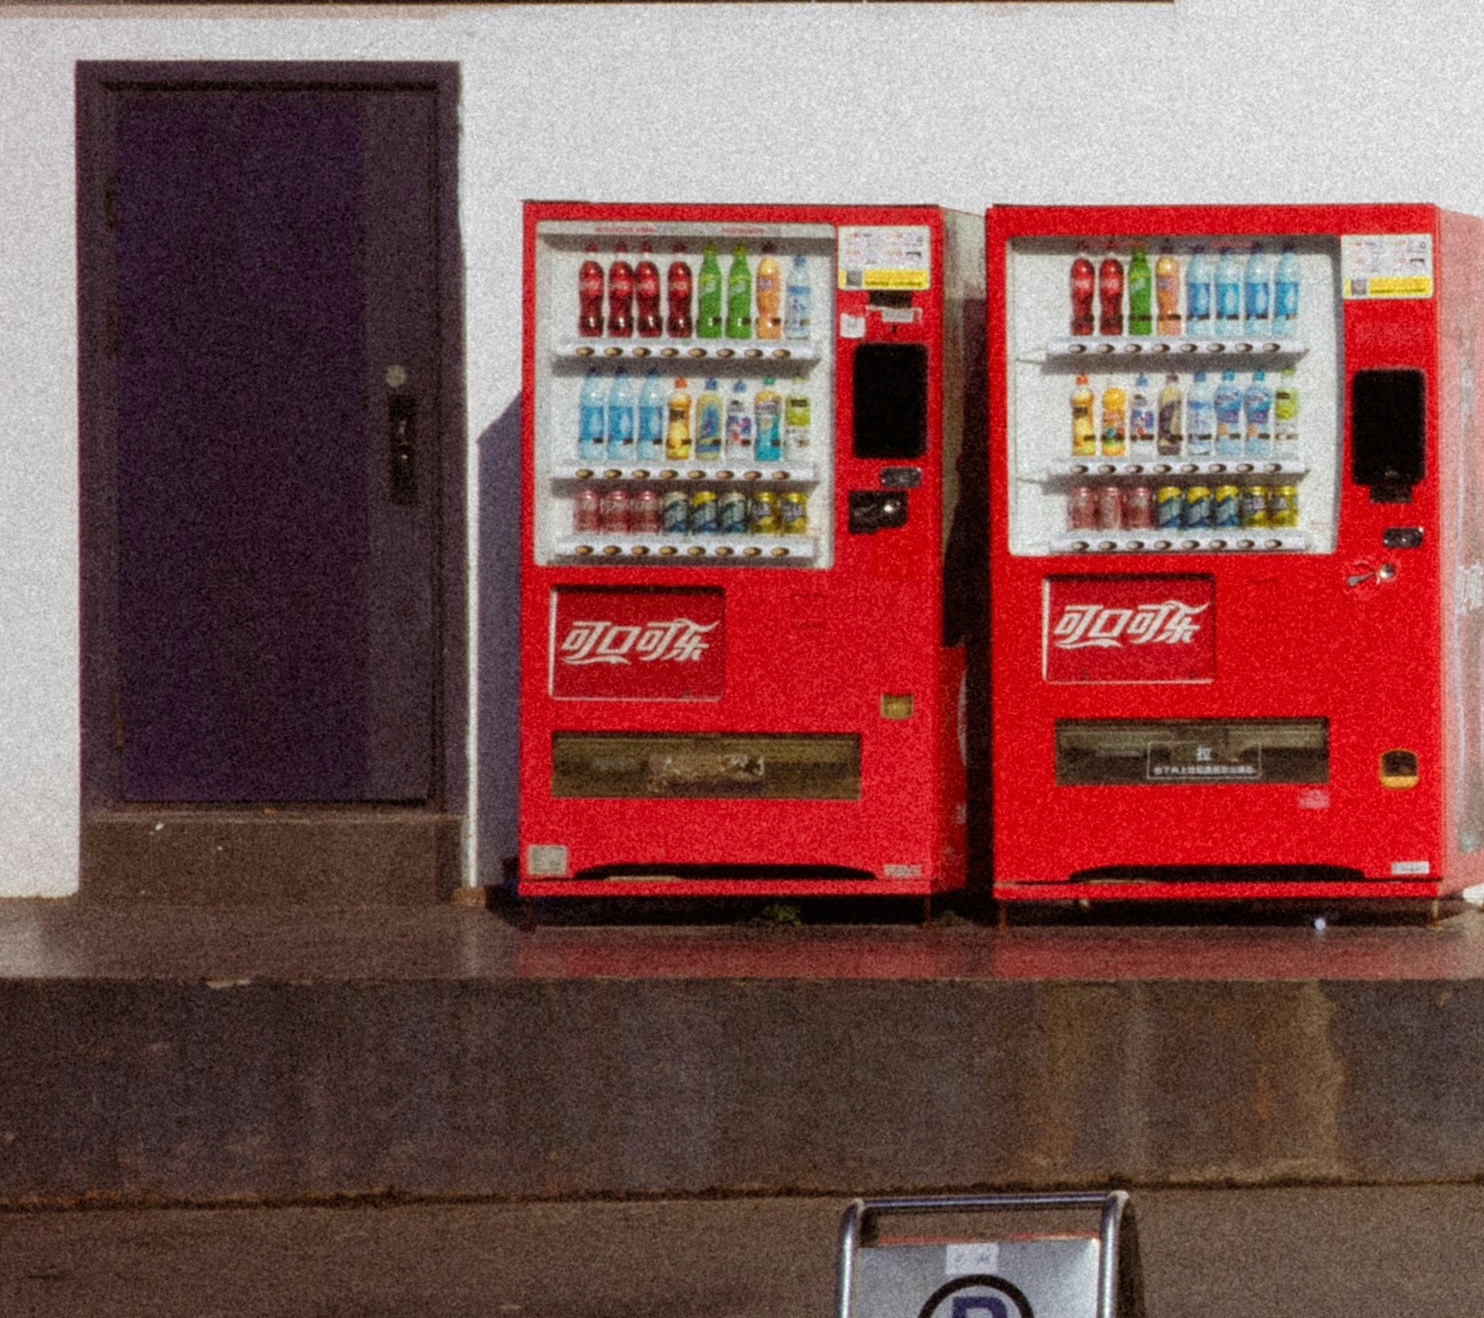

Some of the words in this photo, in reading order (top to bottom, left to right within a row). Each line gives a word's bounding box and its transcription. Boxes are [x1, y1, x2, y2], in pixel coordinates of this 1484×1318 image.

[561, 618, 720, 665] 可口可乐
[1054, 600, 1212, 649] 可口可乐
